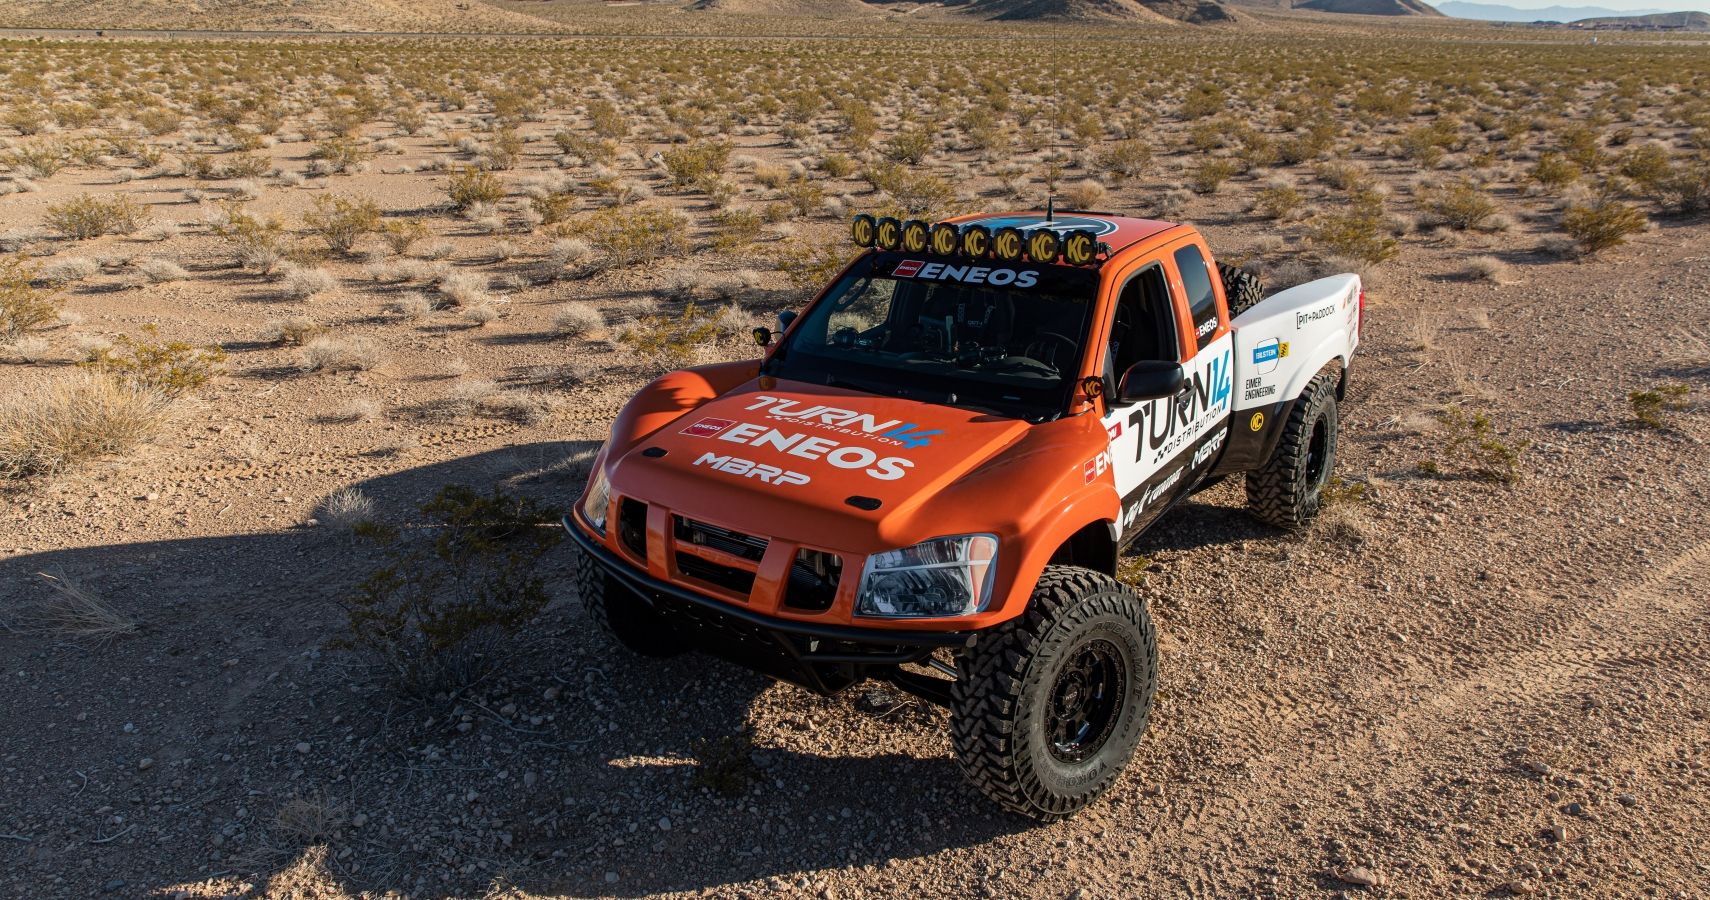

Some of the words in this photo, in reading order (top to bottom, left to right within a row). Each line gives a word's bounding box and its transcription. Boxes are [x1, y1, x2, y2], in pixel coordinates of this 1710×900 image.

[854, 217, 870, 243] KC
[878, 221, 896, 247] KC
[905, 223, 923, 250] KC
[934, 226, 953, 253] KC
[964, 229, 985, 256] KC
[997, 230, 1018, 258] KC
[1031, 232, 1053, 261] KC
[1067, 235, 1091, 263] KC
[918, 263, 1040, 288] ENEOS
[1085, 382, 1100, 396] KC
[1245, 385, 1276, 400] ENGINEERING
[1246, 377, 1262, 389] EIMER
[787, 416, 904, 447] DISTRIBUTION
[1166, 403, 1221, 454] DISTRIBUTION
[718, 422, 915, 481] ENEOS
[692, 452, 811, 486] MBRP
